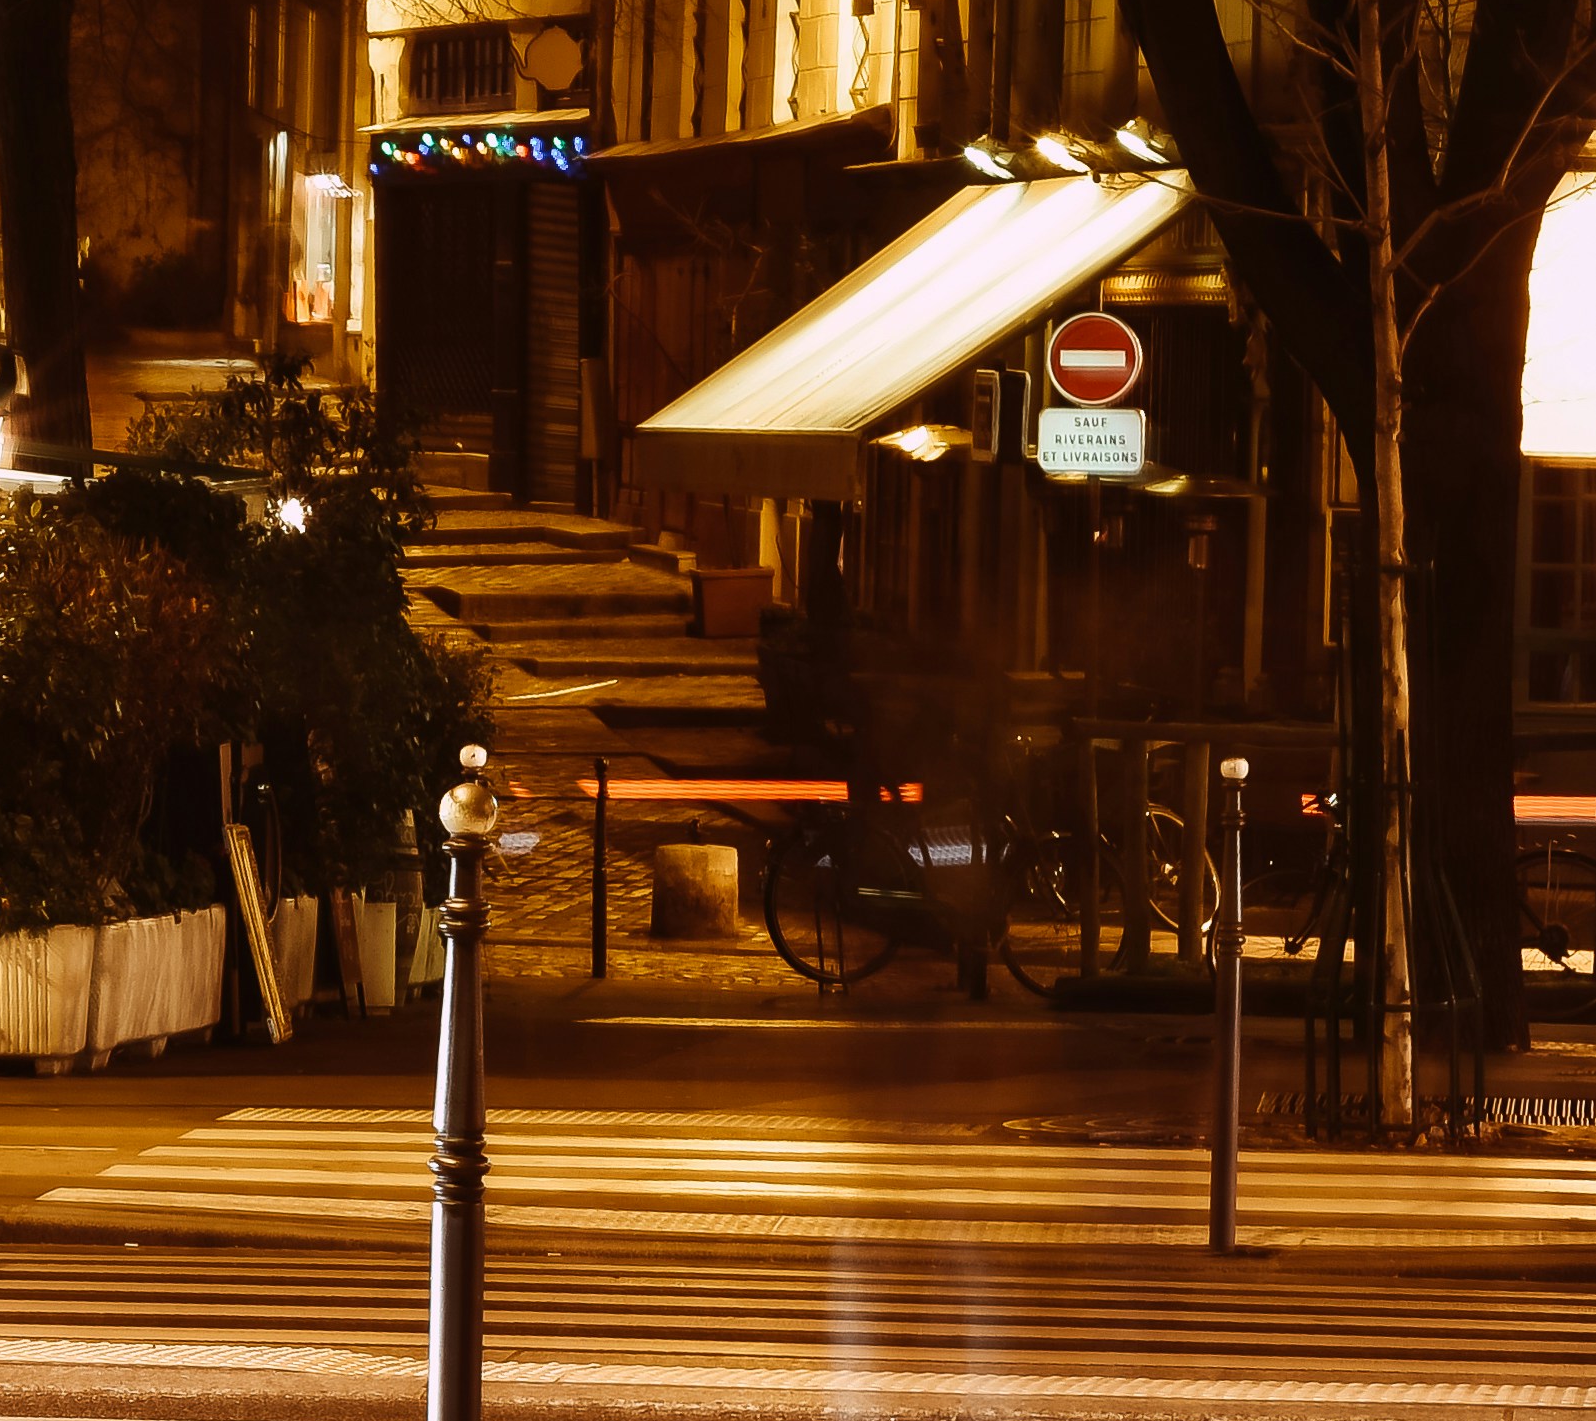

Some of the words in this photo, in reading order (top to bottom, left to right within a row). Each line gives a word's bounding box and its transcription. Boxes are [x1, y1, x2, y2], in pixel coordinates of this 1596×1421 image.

[1074, 416, 1109, 428] SAUF
[1055, 434, 1127, 445] RIVERAINS
[1042, 452, 1057, 462] ET
[1062, 451, 1138, 463] LIVRAISONS
